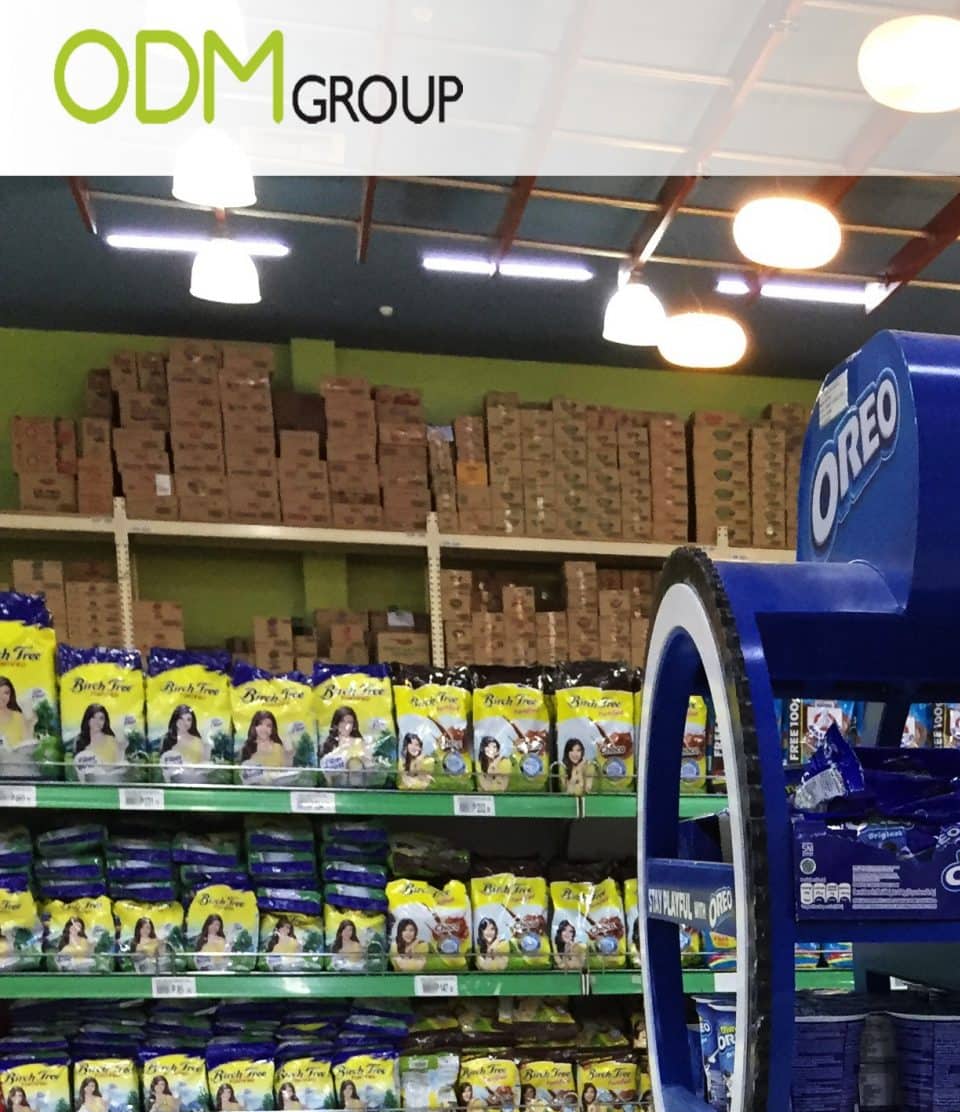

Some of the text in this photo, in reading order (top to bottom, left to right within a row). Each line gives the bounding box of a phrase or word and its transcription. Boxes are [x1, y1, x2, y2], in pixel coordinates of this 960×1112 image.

[811, 378, 897, 546] OREO
[16, 646, 41, 661] Tree
[71, 677, 132, 693] Birch Tree
[161, 681, 220, 696] Birch Tree
[484, 694, 538, 707] Birch Tree
[569, 696, 622, 708] Birch Tree
[789, 729, 799, 761] FREE
[663, 890, 693, 921] PLAYFUL
[709, 889, 733, 929] OREO
[213, 1066, 267, 1083] Birch Tree
[365, 1063, 386, 1075] Tree
[522, 1067, 571, 1080] Birch Tree
[4, 1070, 60, 1084] Birch Tree
